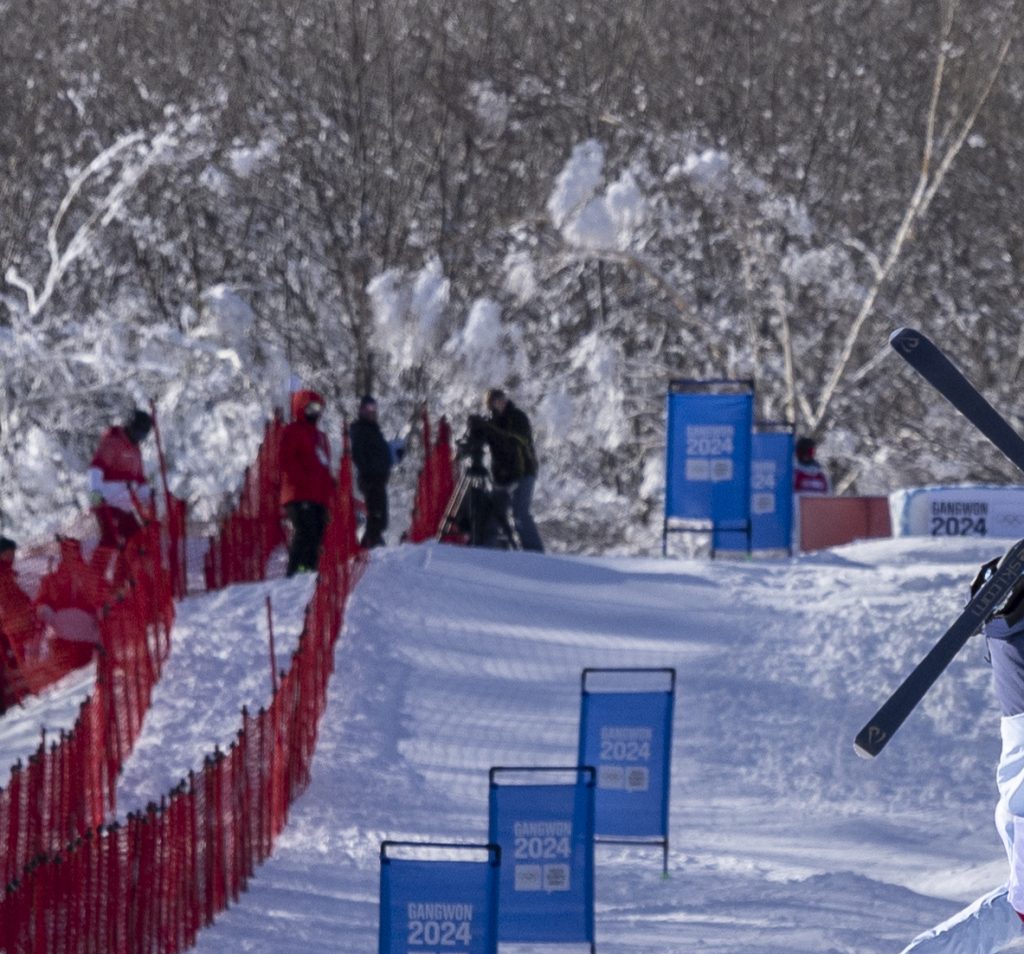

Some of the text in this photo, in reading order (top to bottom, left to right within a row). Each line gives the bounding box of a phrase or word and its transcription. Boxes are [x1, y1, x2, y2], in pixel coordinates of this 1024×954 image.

[932, 517, 987, 536] 2024
[601, 741, 650, 760] 2024
[515, 837, 571, 858] 2024
[408, 903, 472, 920] GANGWON
[408, 921, 472, 945] 2024
